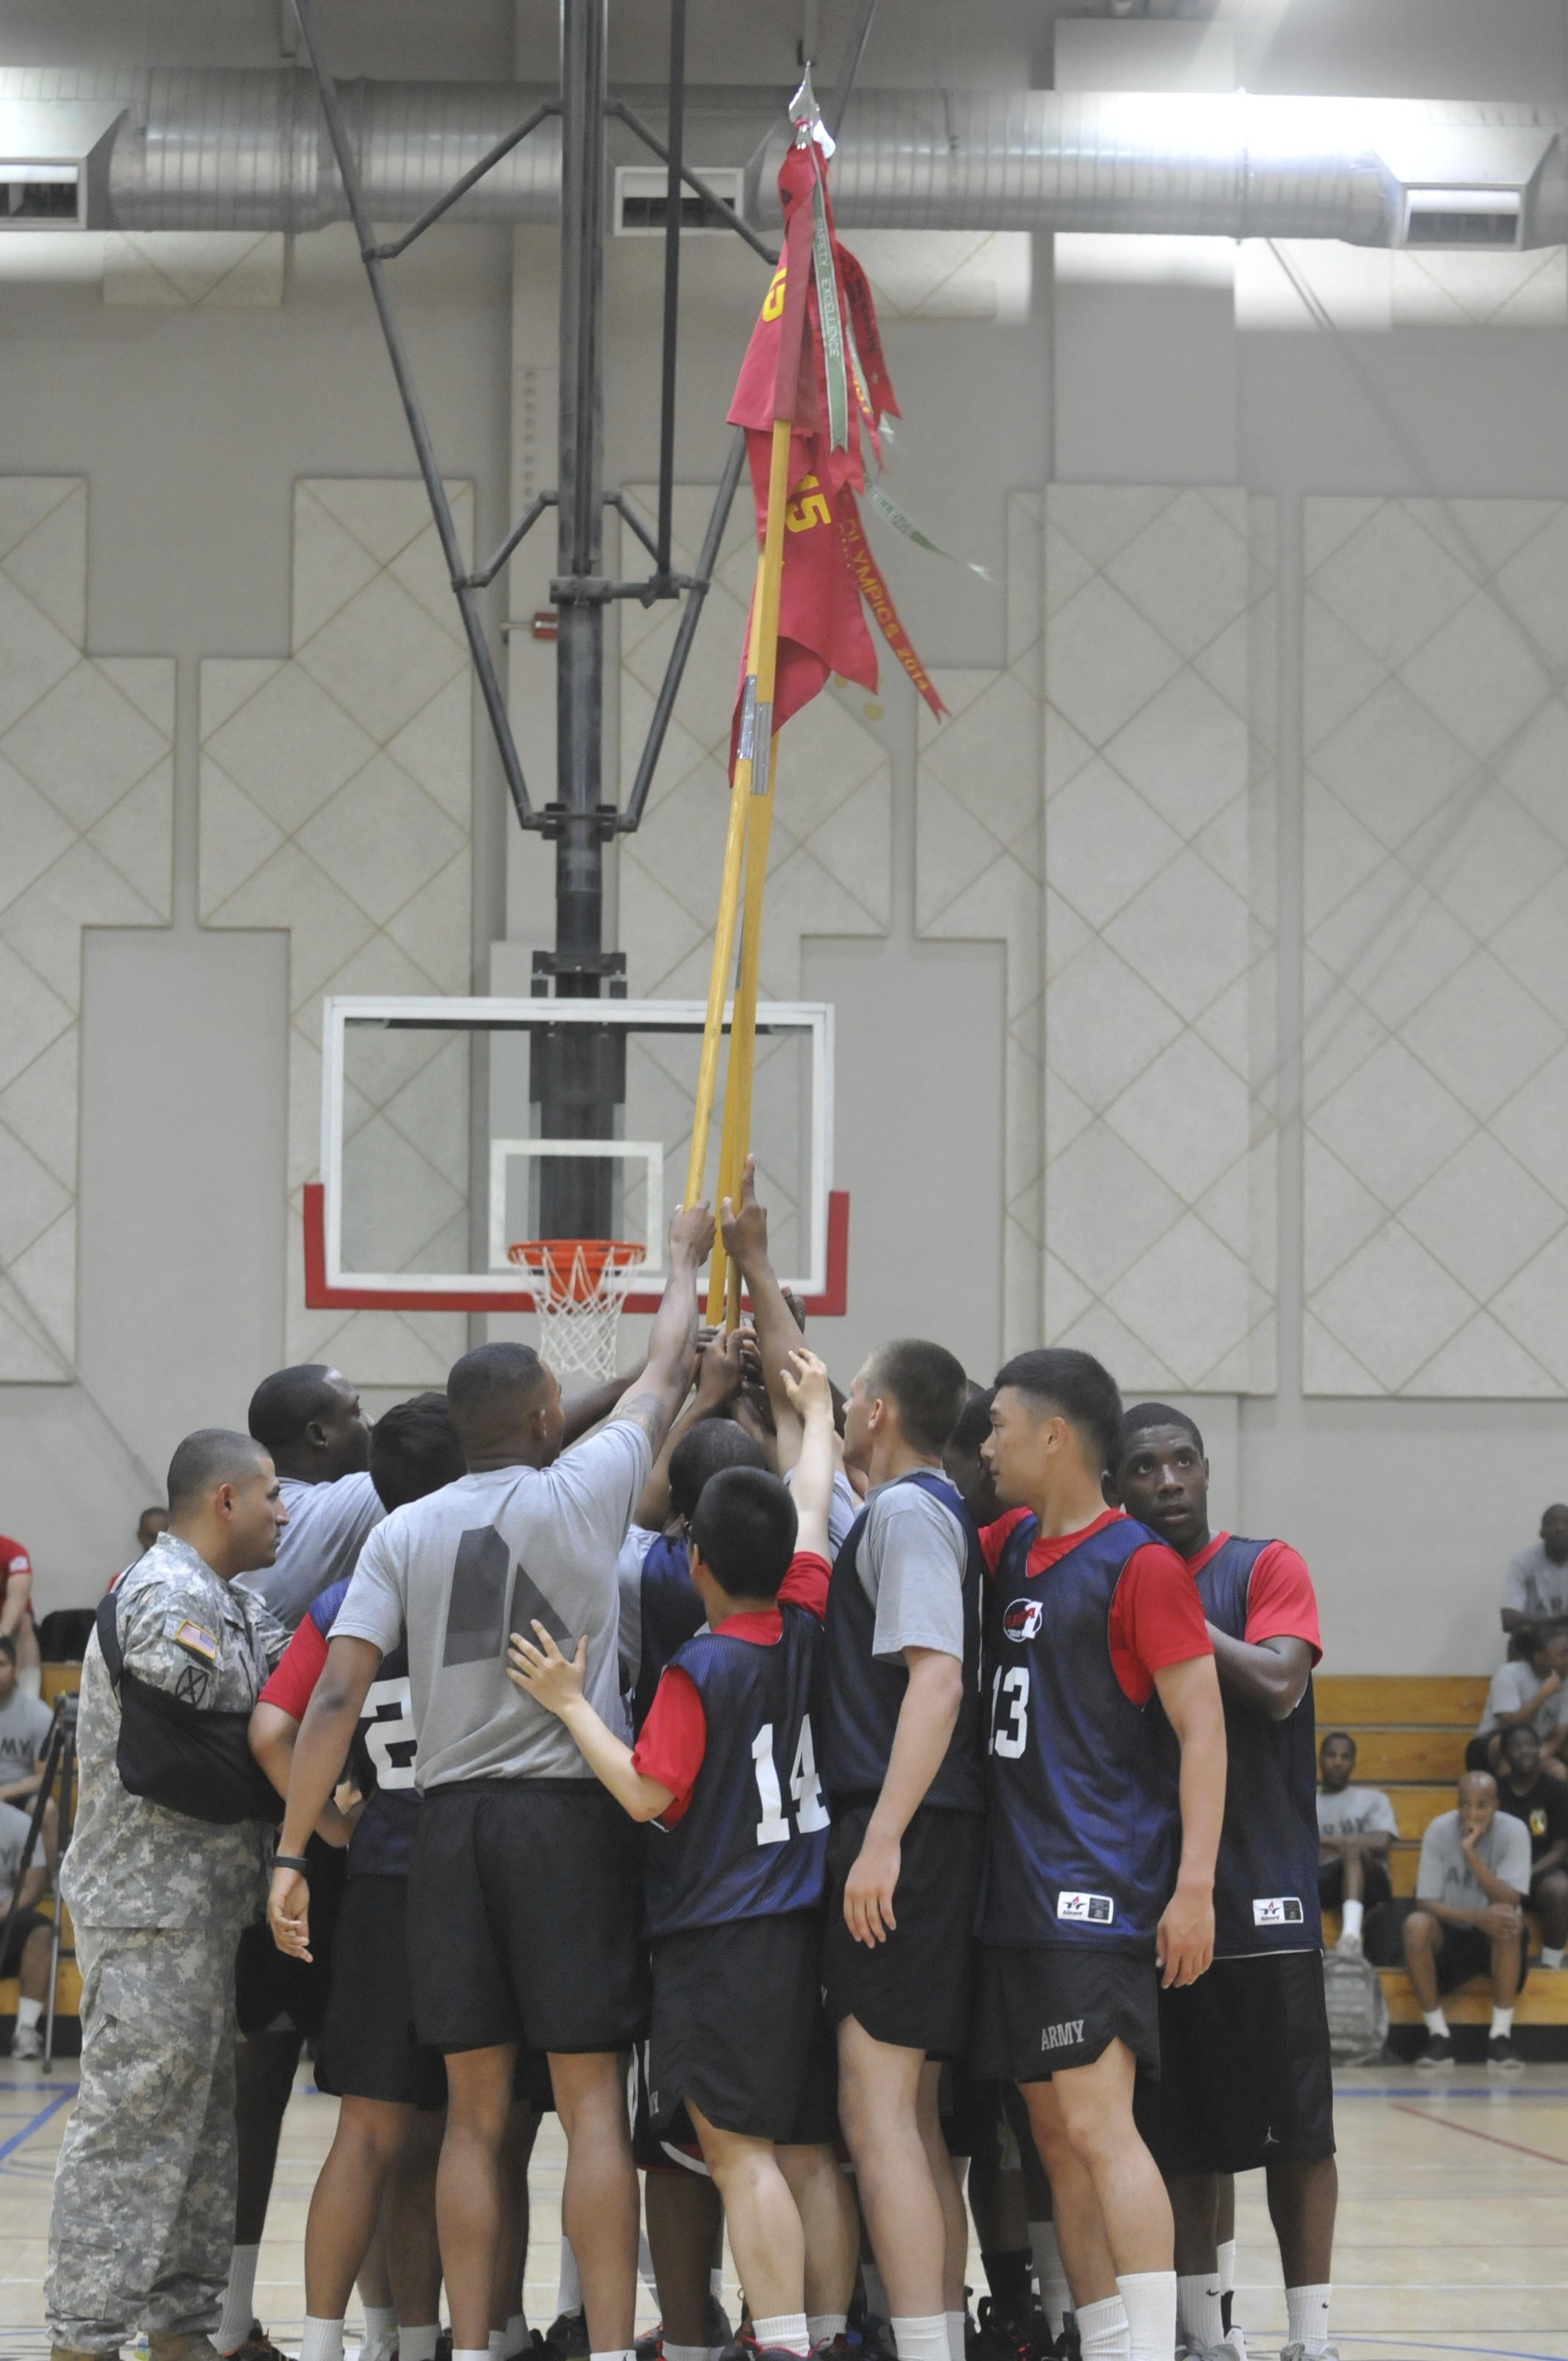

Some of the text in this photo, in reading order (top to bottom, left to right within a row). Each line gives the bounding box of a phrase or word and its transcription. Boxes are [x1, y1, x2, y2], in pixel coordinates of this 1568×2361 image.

[816, 219, 841, 358] SAFETY EXCELLENCE
[752, 1714, 831, 1846] 14
[1041, 2019, 1084, 2051] ARMY
